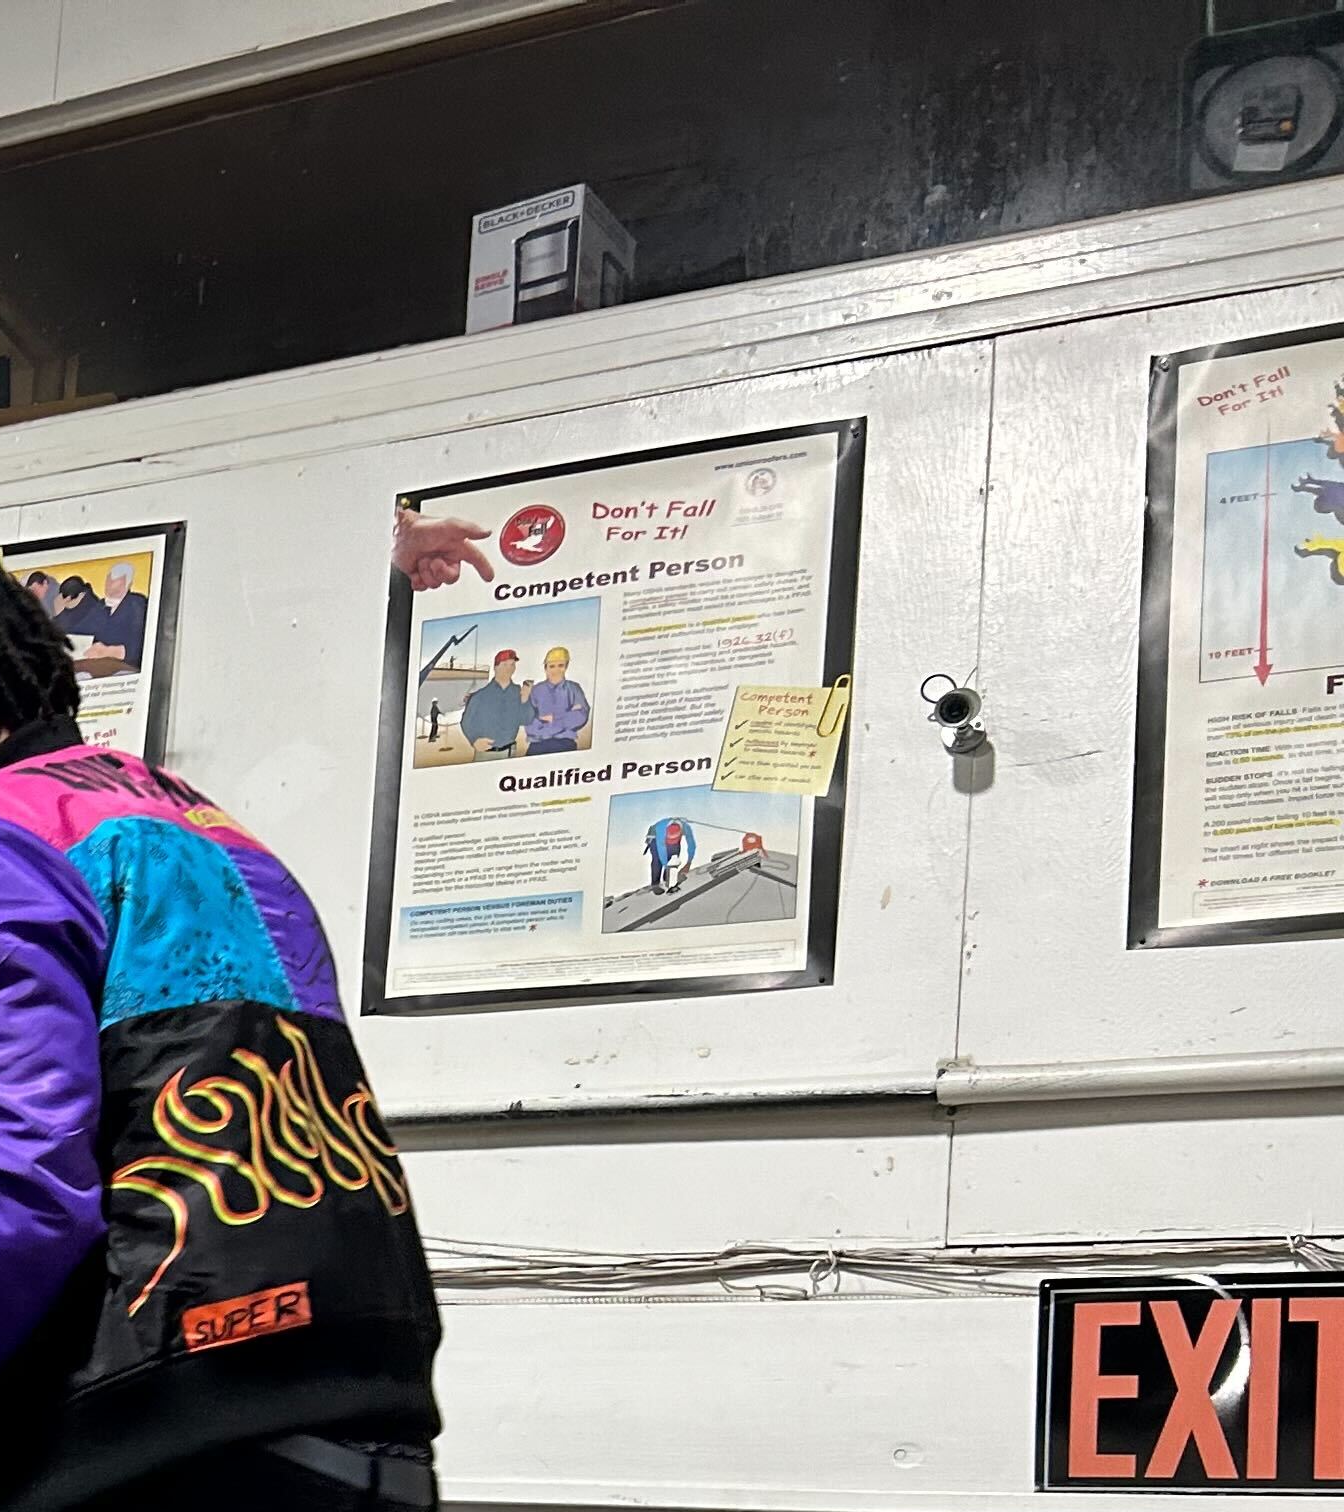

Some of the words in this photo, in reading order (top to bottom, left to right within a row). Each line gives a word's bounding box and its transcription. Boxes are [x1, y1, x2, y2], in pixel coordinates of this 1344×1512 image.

[1197, 384, 1249, 407] Don't
[1253, 366, 1291, 388] Fall
[1218, 400, 1251, 416] For
[1256, 386, 1284, 403] It!
[1230, 493, 1259, 503] FEET
[592, 501, 658, 520] Don't
[666, 499, 717, 519] Fall
[606, 526, 646, 542] For
[653, 525, 687, 541] It!
[494, 564, 647, 601] Competent
[649, 553, 745, 580] Person
[1208, 651, 1221, 659] 10
[1224, 647, 1254, 657] FEET
[740, 692, 813, 705] Competent
[758, 705, 810, 718] Person
[1232, 713, 1253, 721] RISK
[94, 728, 117, 739] Fall
[1206, 748, 1249, 758] REACTION
[499, 764, 613, 794] Qualified
[621, 755, 712, 781] Person
[1206, 774, 1243, 784] SUDDEN
[1243, 771, 1273, 780] STOPS
[1269, 872, 1293, 881] FREE
[1294, 868, 1337, 878] BOOKLET
[193, 1290, 301, 1346] SUPER
[1068, 1297, 1344, 1480] EXIT
